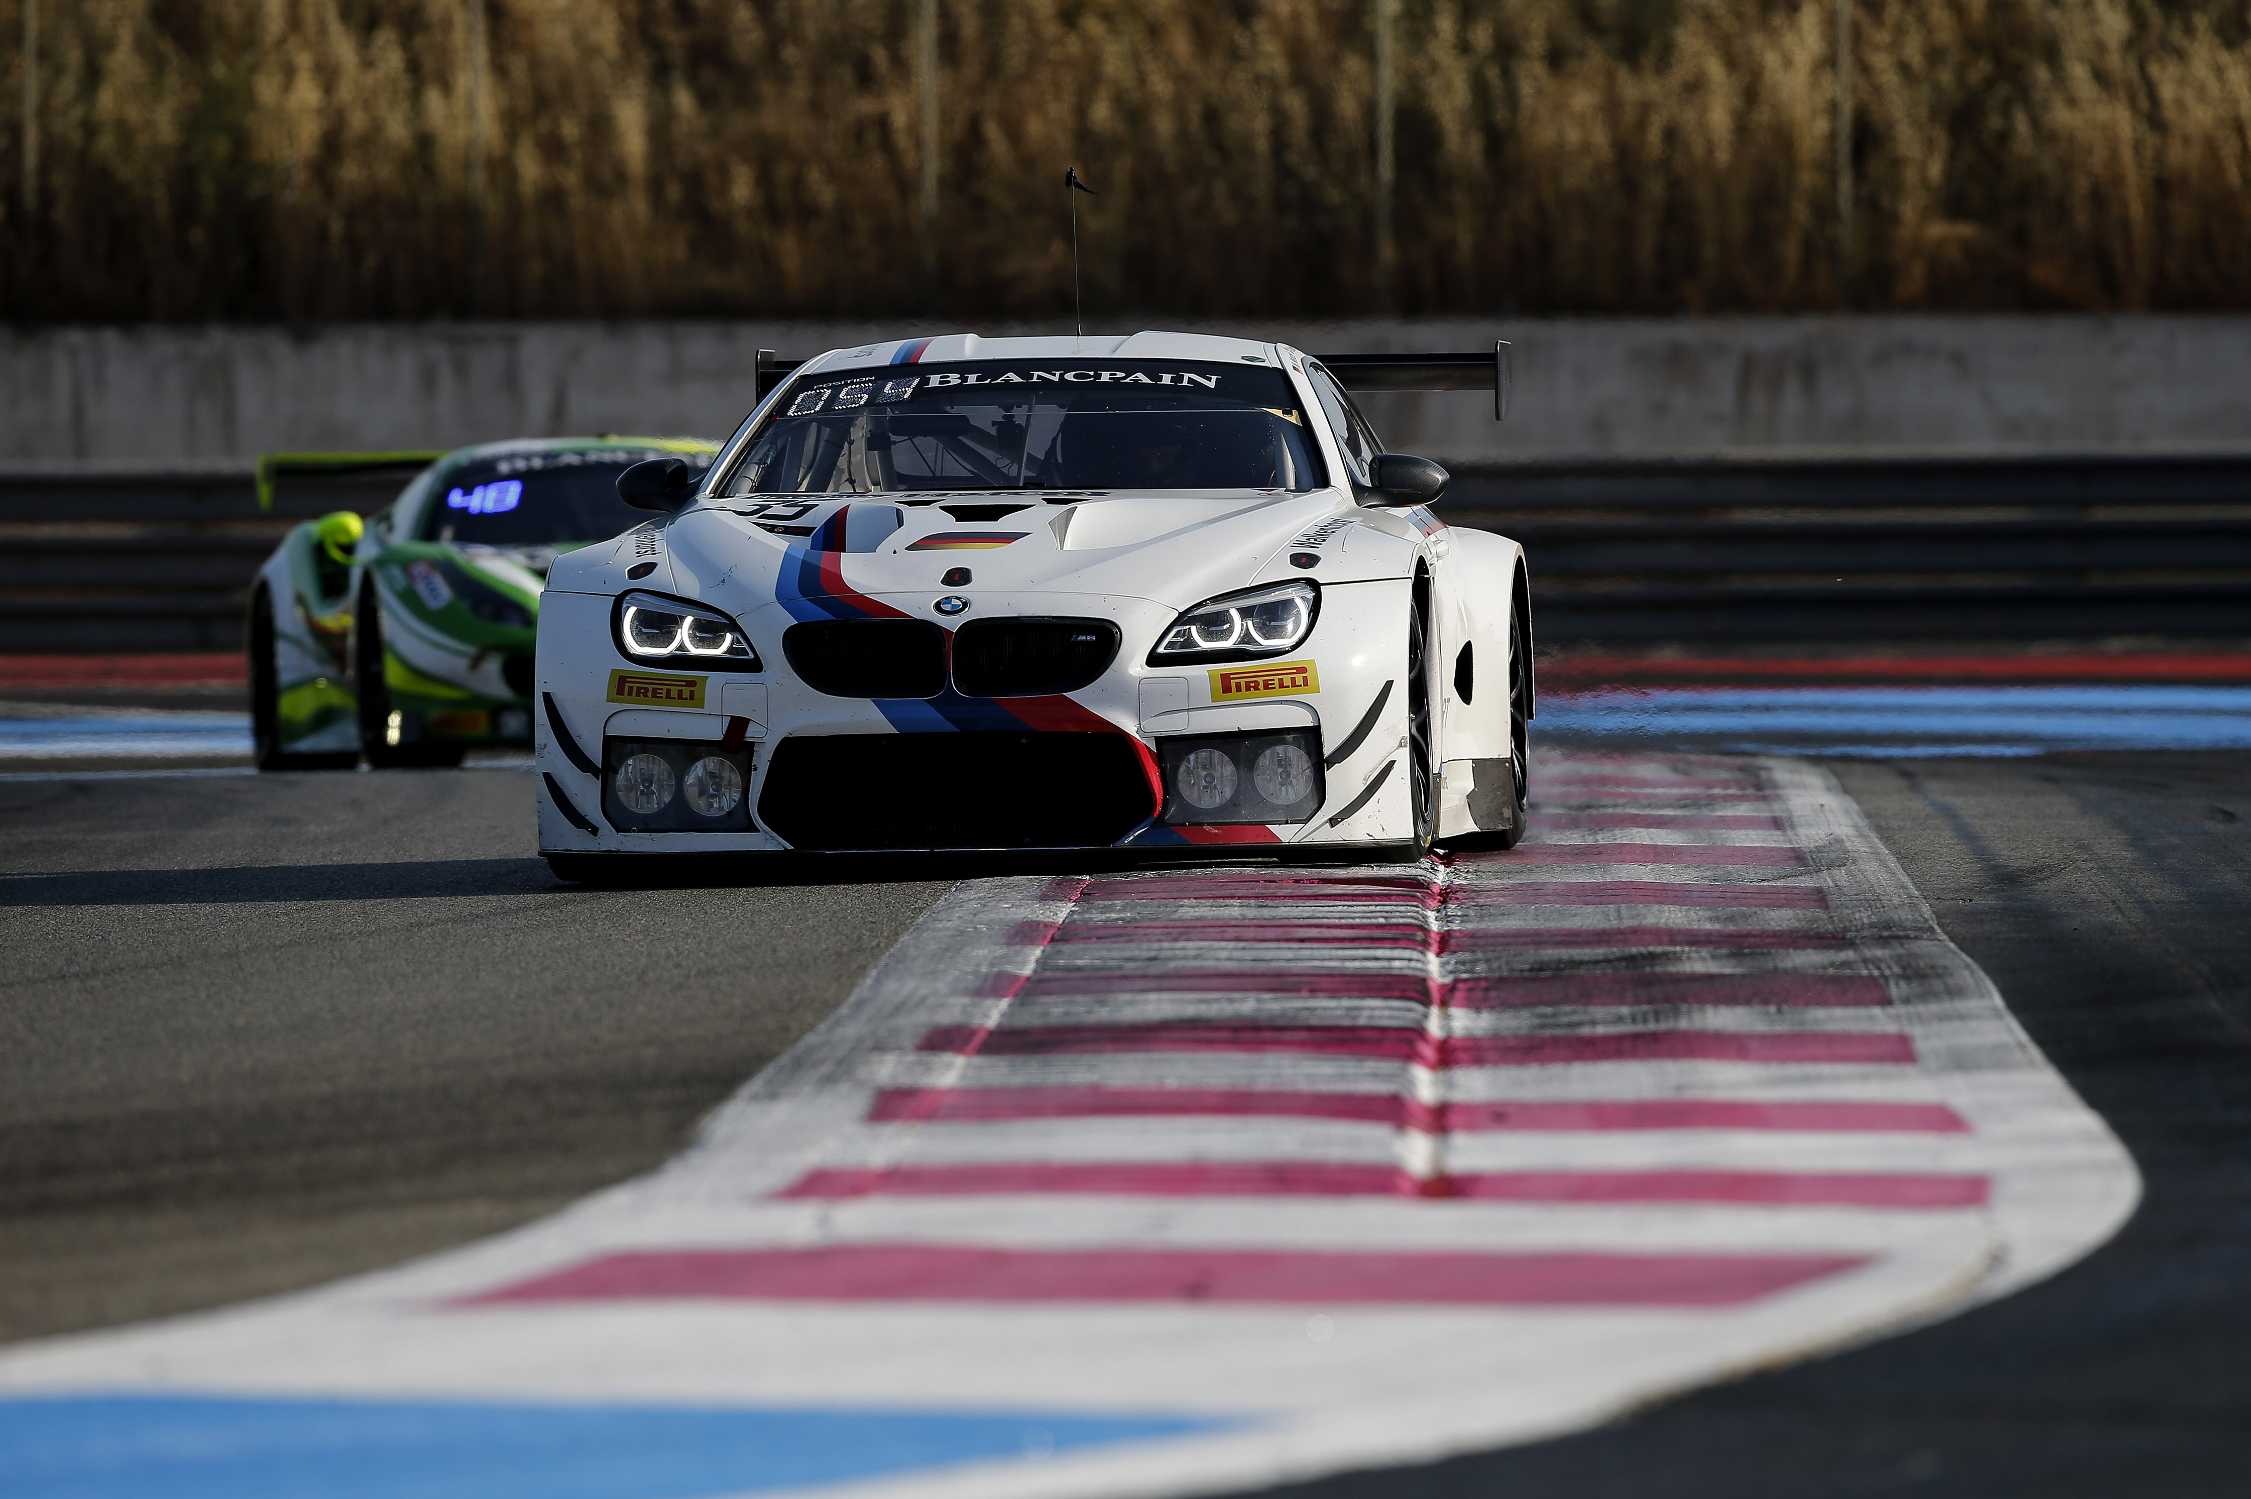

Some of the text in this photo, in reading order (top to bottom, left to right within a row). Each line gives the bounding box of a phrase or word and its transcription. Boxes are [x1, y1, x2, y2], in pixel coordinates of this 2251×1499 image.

[813, 376, 875, 389] POSITION
[924, 371, 1222, 389] BLANCPAIN
[615, 674, 698, 701] PIRELLI
[1219, 665, 1309, 695] PIRELLI
